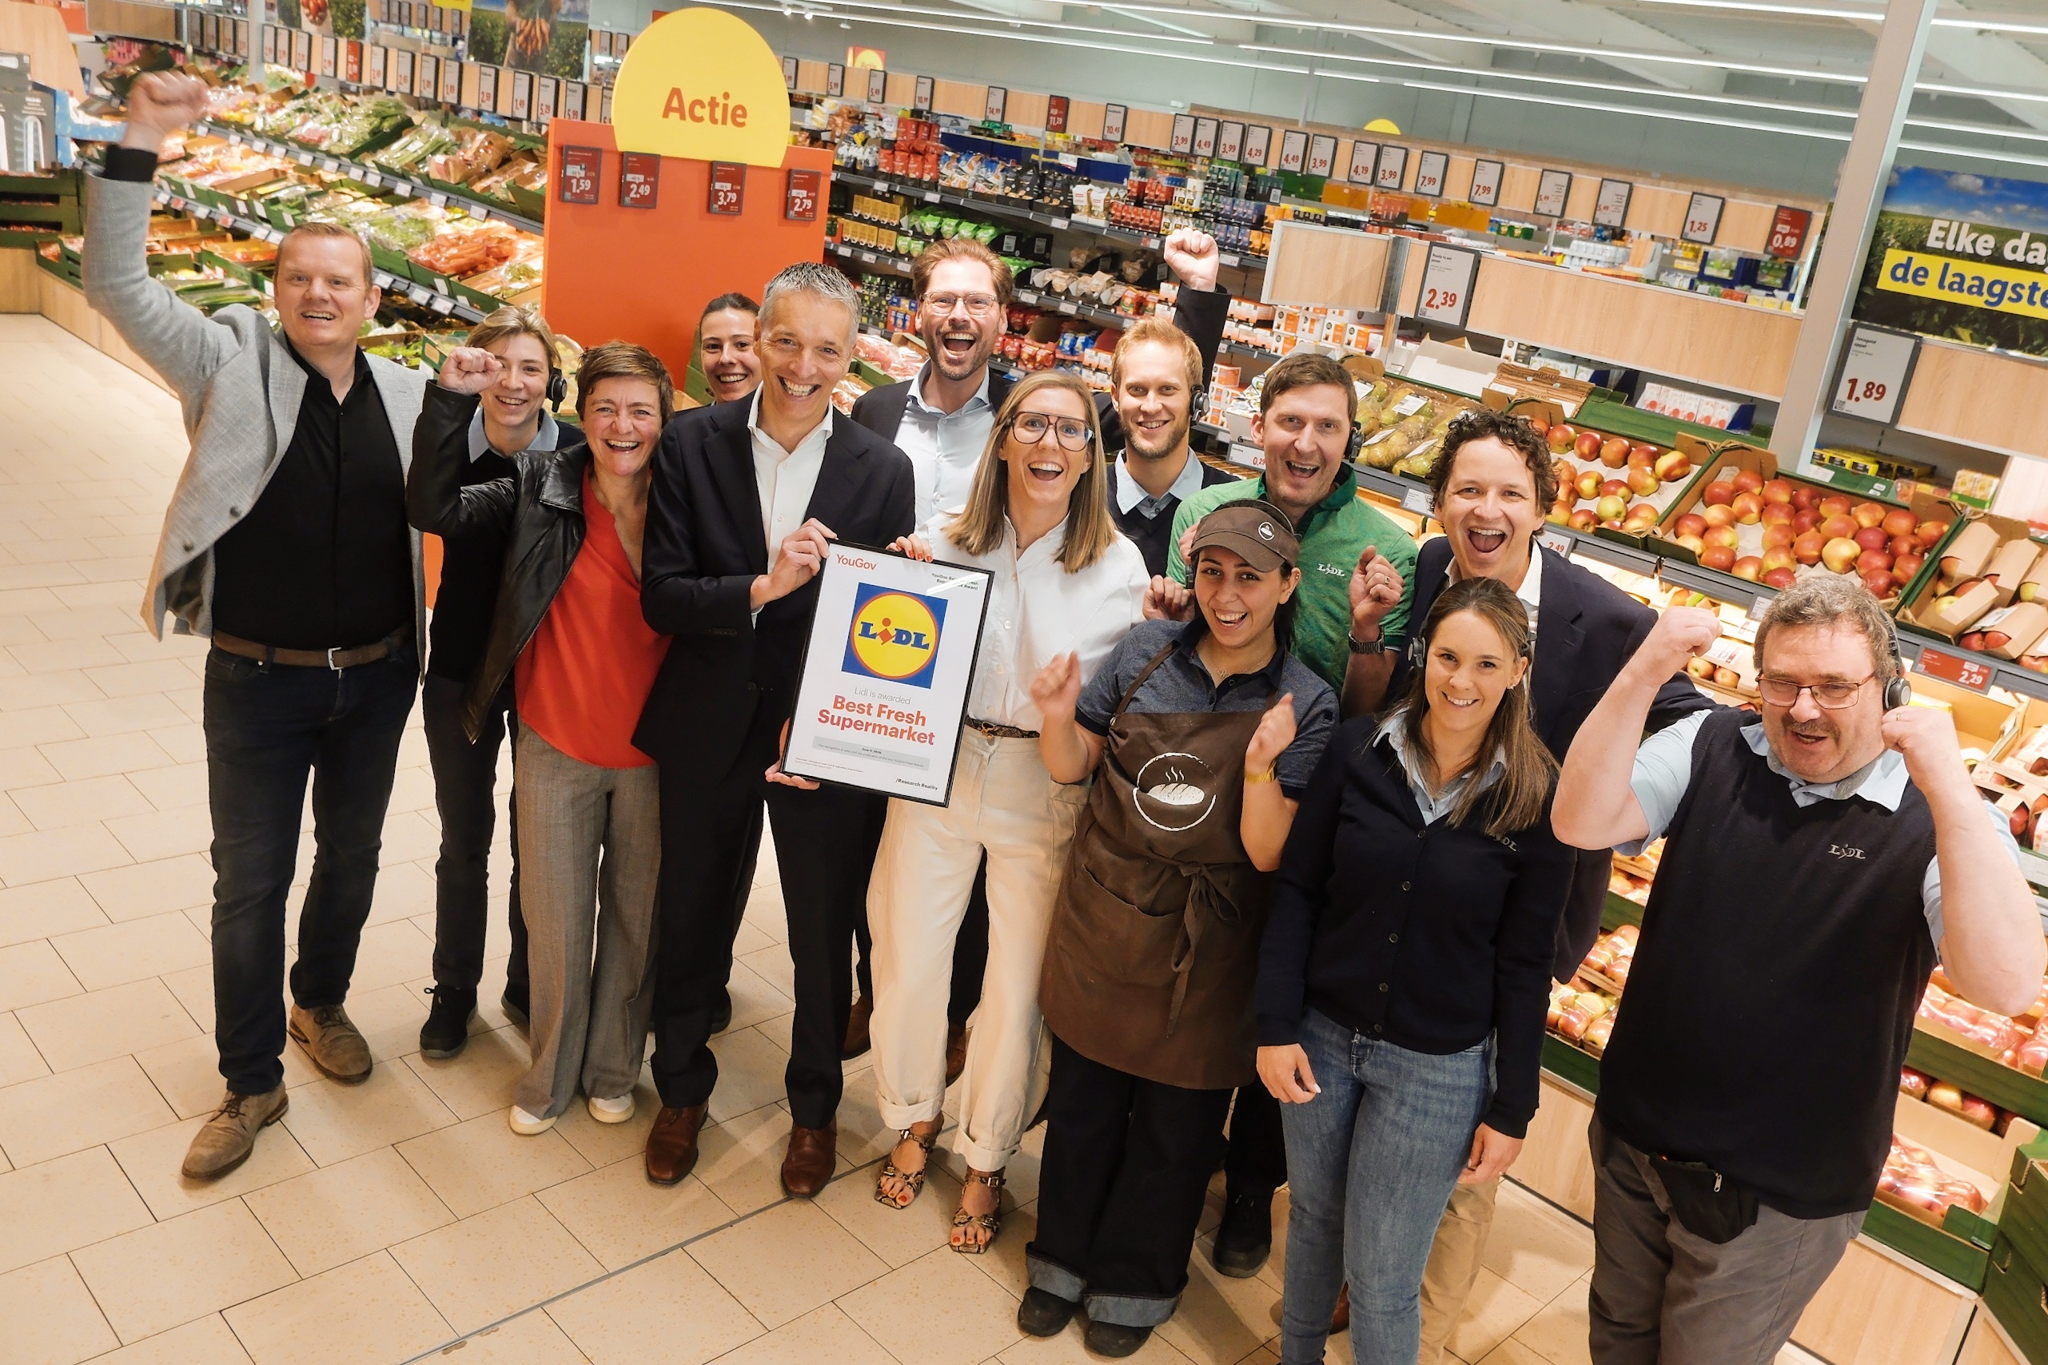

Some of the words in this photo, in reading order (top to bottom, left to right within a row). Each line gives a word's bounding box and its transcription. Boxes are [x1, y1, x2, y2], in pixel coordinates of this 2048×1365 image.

[662, 87, 747, 128] Actie
[1174, 135, 1189, 147] 3.99
[1197, 139, 1211, 150] 4.49
[1221, 143, 1237, 154] 3.99
[1283, 153, 1300, 165] 4.49
[1311, 157, 1327, 169] 3.99
[1381, 168, 1397, 182] 3.99
[1421, 175, 1437, 187] 7.99
[570, 178, 591, 194] 1.59
[629, 183, 651, 198] 2.49
[1475, 184, 1492, 197] 7.99
[717, 191, 737, 206] 3.79
[793, 198, 813, 213] 2.79
[1690, 220, 1708, 233] 1.25
[1772, 233, 1797, 249] 0.89
[1926, 218, 1996, 257] Elke
[2003, 231, 2048, 274] da
[1890, 256, 1930, 287] de
[1426, 288, 1457, 310] 2.39
[1847, 377, 1887, 402] 1.89
[837, 554, 877, 570] YouGov
[1958, 670, 1983, 685] 2.29
[854, 687, 868, 697] Lidl
[869, 690, 877, 698] is
[877, 692, 912, 705] awarded
[832, 695, 873, 716] Best
[876, 703, 927, 727] Fresh
[817, 709, 936, 746] Supermarket
